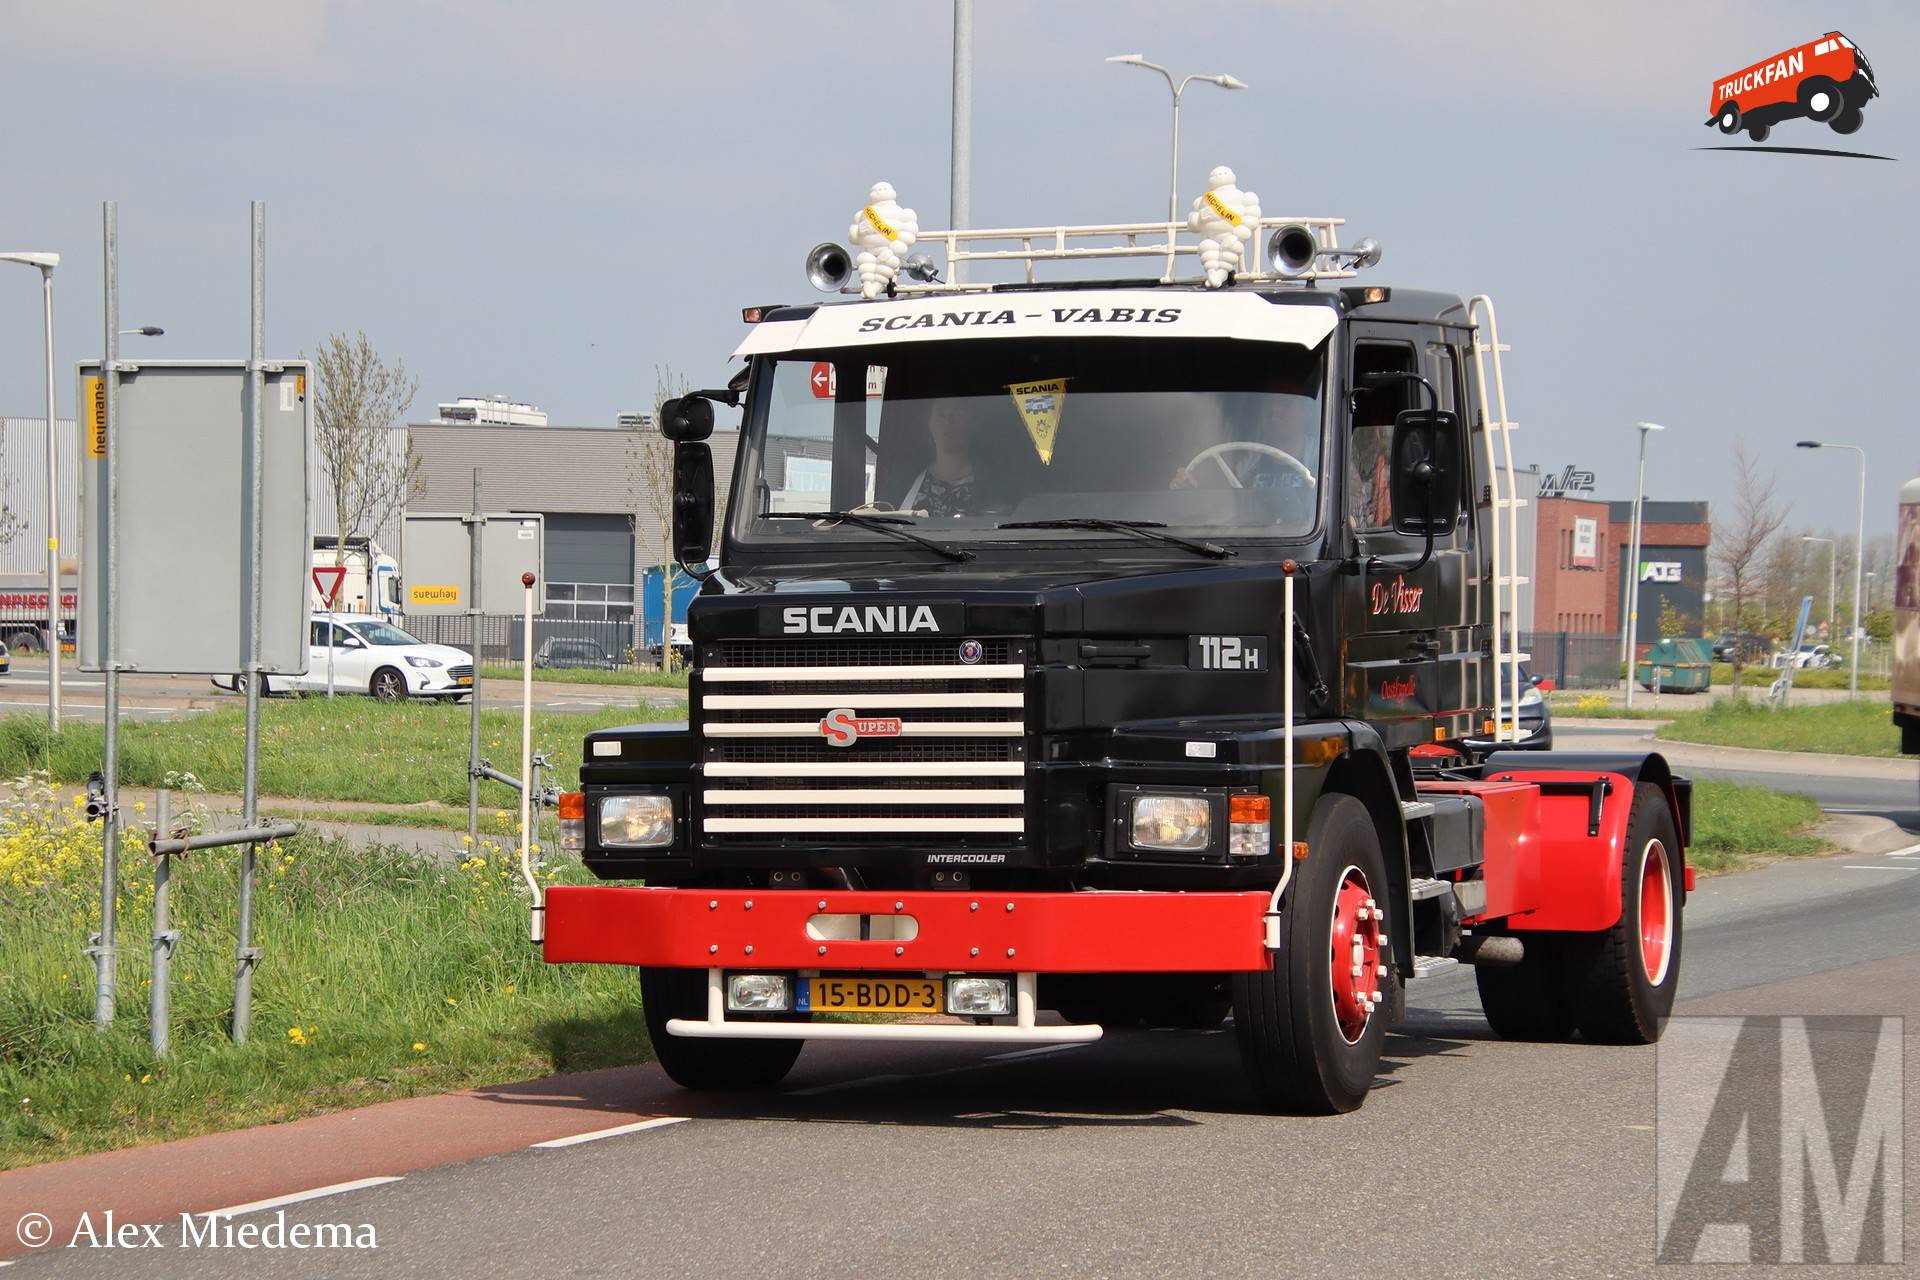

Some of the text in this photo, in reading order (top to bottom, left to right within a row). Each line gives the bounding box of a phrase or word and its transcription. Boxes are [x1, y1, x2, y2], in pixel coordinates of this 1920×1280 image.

[1205, 192, 1235, 221] MICHELIN
[865, 207, 892, 236] MICHELIN
[1016, 383, 1060, 396] SCANIA
[1372, 573, 1424, 615] De Visser
[783, 605, 940, 634] SCANIA
[927, 854, 1006, 863] INTERCOOLER
[798, 983, 936, 1008] NL 15-BDD-3
